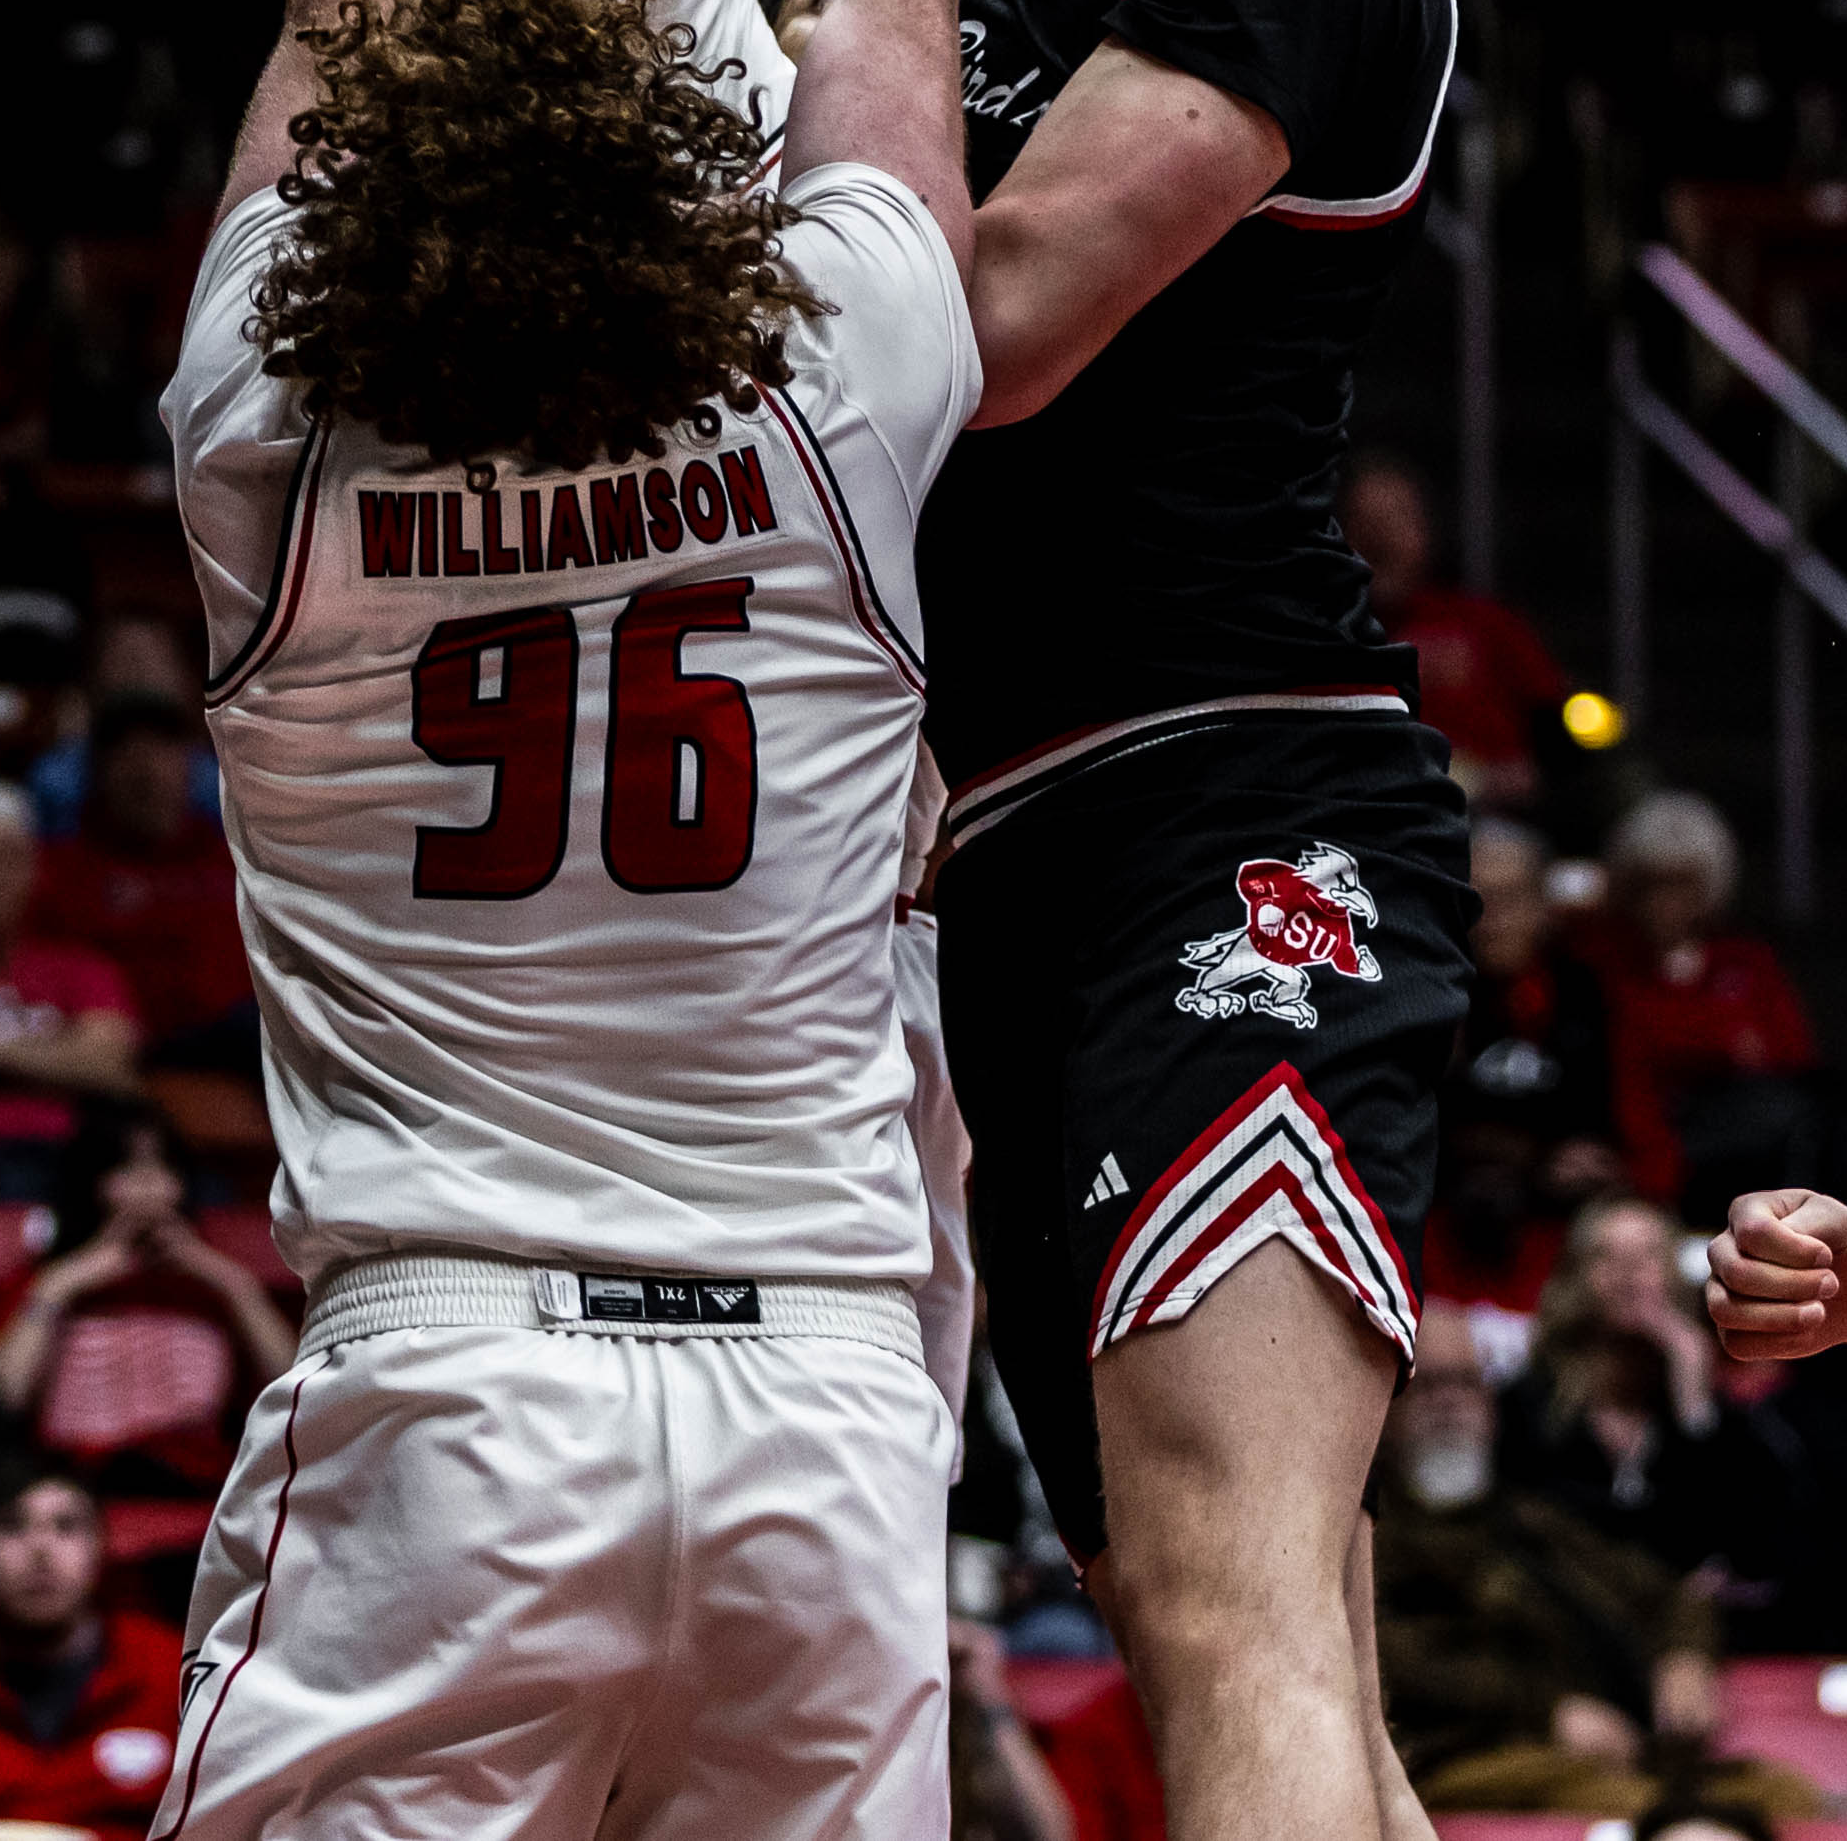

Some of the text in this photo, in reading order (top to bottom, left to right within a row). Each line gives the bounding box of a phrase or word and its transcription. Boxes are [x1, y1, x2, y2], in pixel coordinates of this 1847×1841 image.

[358, 444, 778, 578] WILLIAMSON
[411, 576, 759, 901] 96
[1284, 911, 1337, 960] SU
[655, 1285, 687, 1301] 2XL
